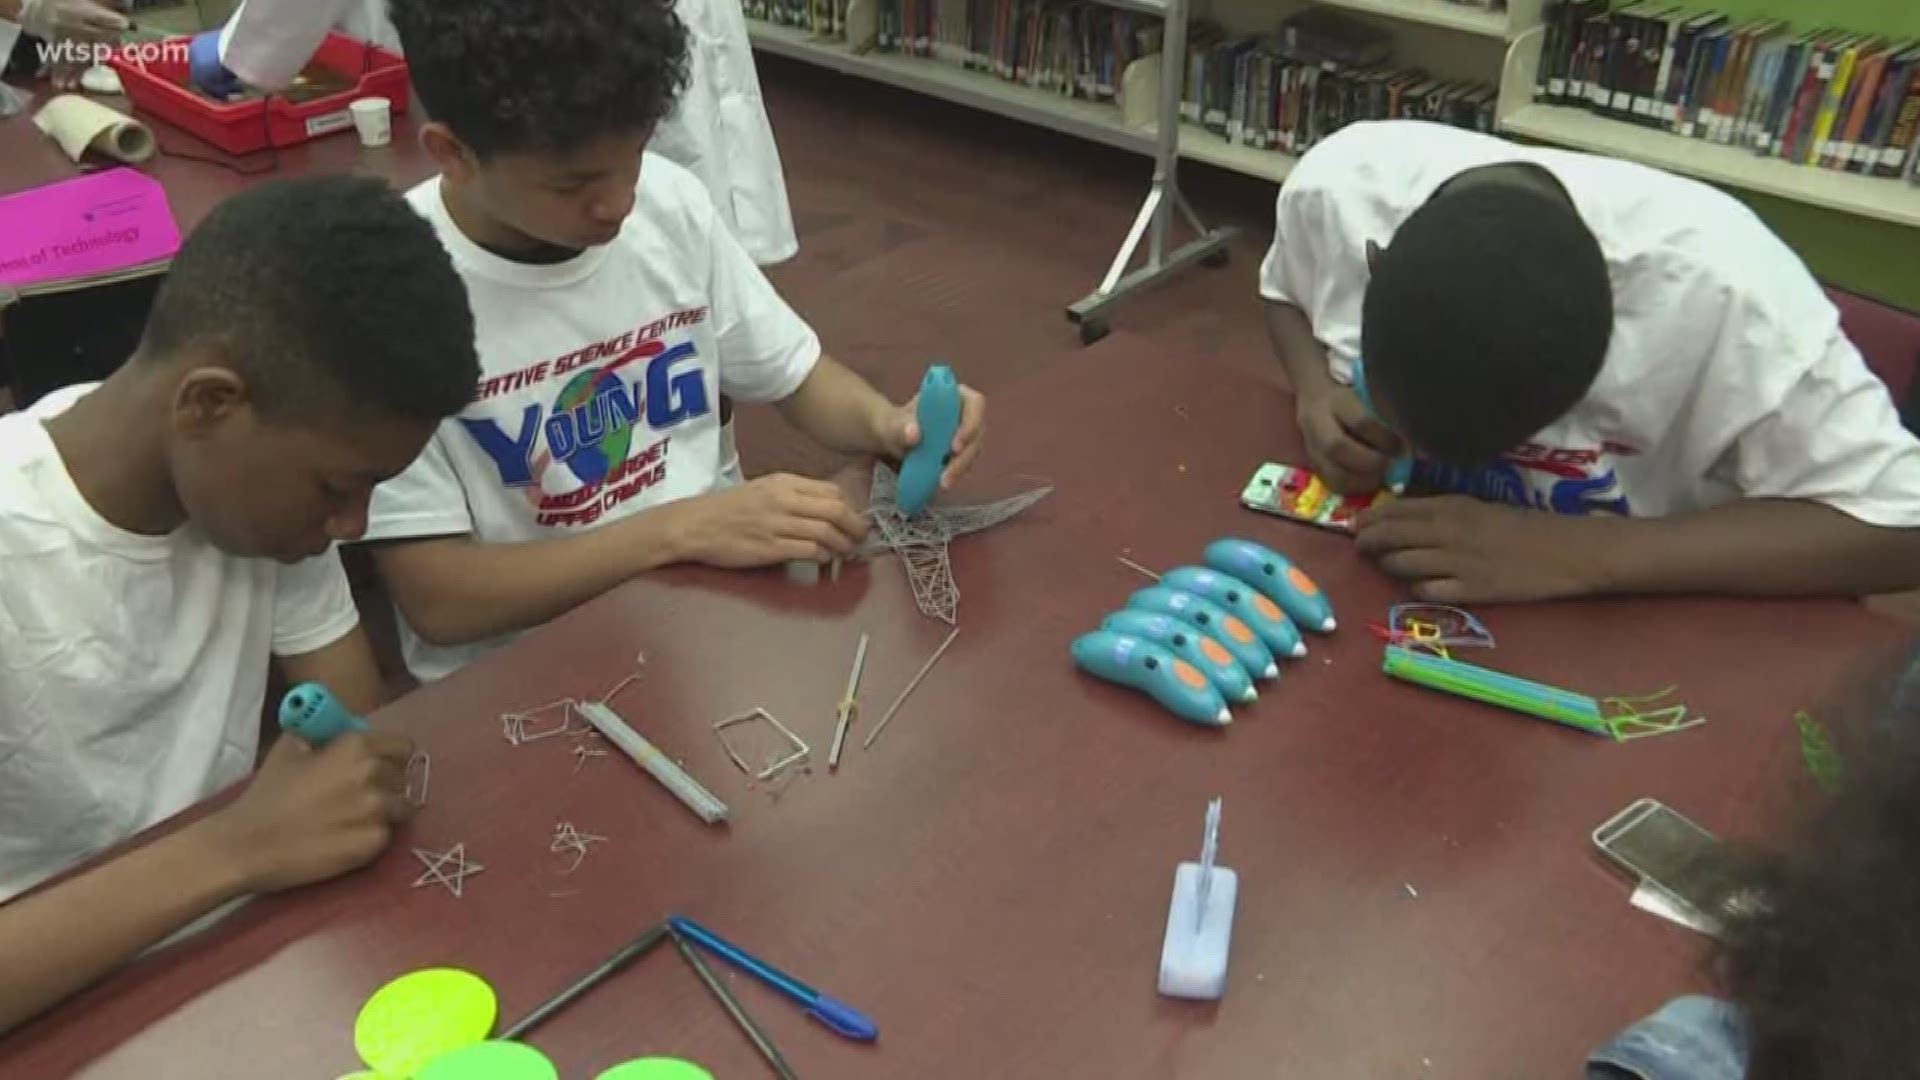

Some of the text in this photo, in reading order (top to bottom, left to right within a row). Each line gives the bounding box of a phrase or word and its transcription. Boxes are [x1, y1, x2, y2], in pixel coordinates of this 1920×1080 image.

[30, 247, 48, 265] of
[53, 227, 140, 258] Technology
[553, 331, 634, 376] SCIENCE
[636, 306, 708, 345] CENTRE
